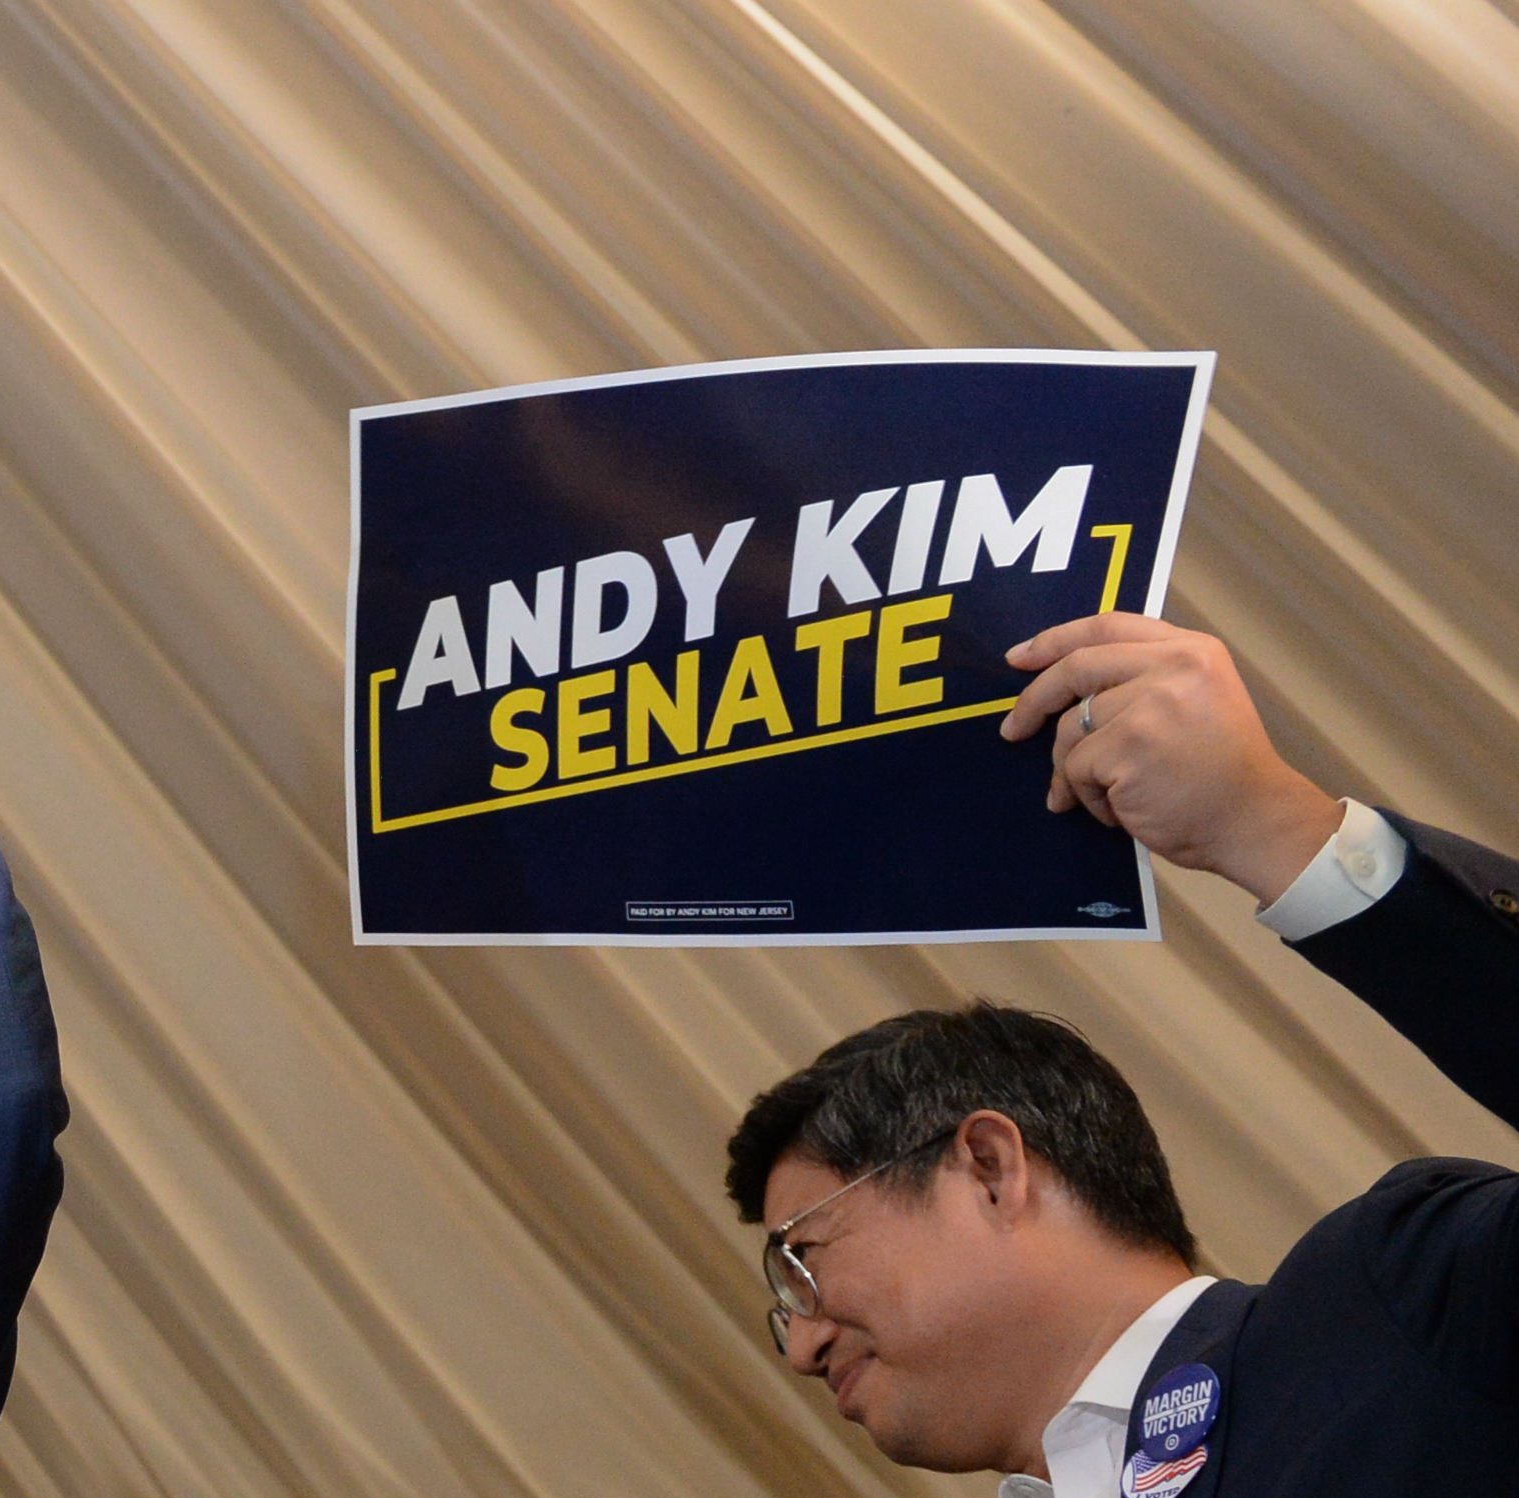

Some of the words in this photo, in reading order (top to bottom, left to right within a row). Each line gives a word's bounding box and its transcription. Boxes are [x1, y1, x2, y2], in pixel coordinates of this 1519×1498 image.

[396, 517, 756, 710] ANDY
[787, 464, 1093, 617] KIM
[489, 593, 953, 791] SENATE
[649, 908, 664, 916] FOR
[677, 907, 700, 916] ANDY
[701, 907, 716, 916] KIM
[718, 907, 736, 916] FOR
[737, 907, 757, 916] NEW
[758, 906, 788, 916] JERSEY
[1144, 1379, 1213, 1418] MARGIN
[1143, 1404, 1209, 1439] VICTORY
